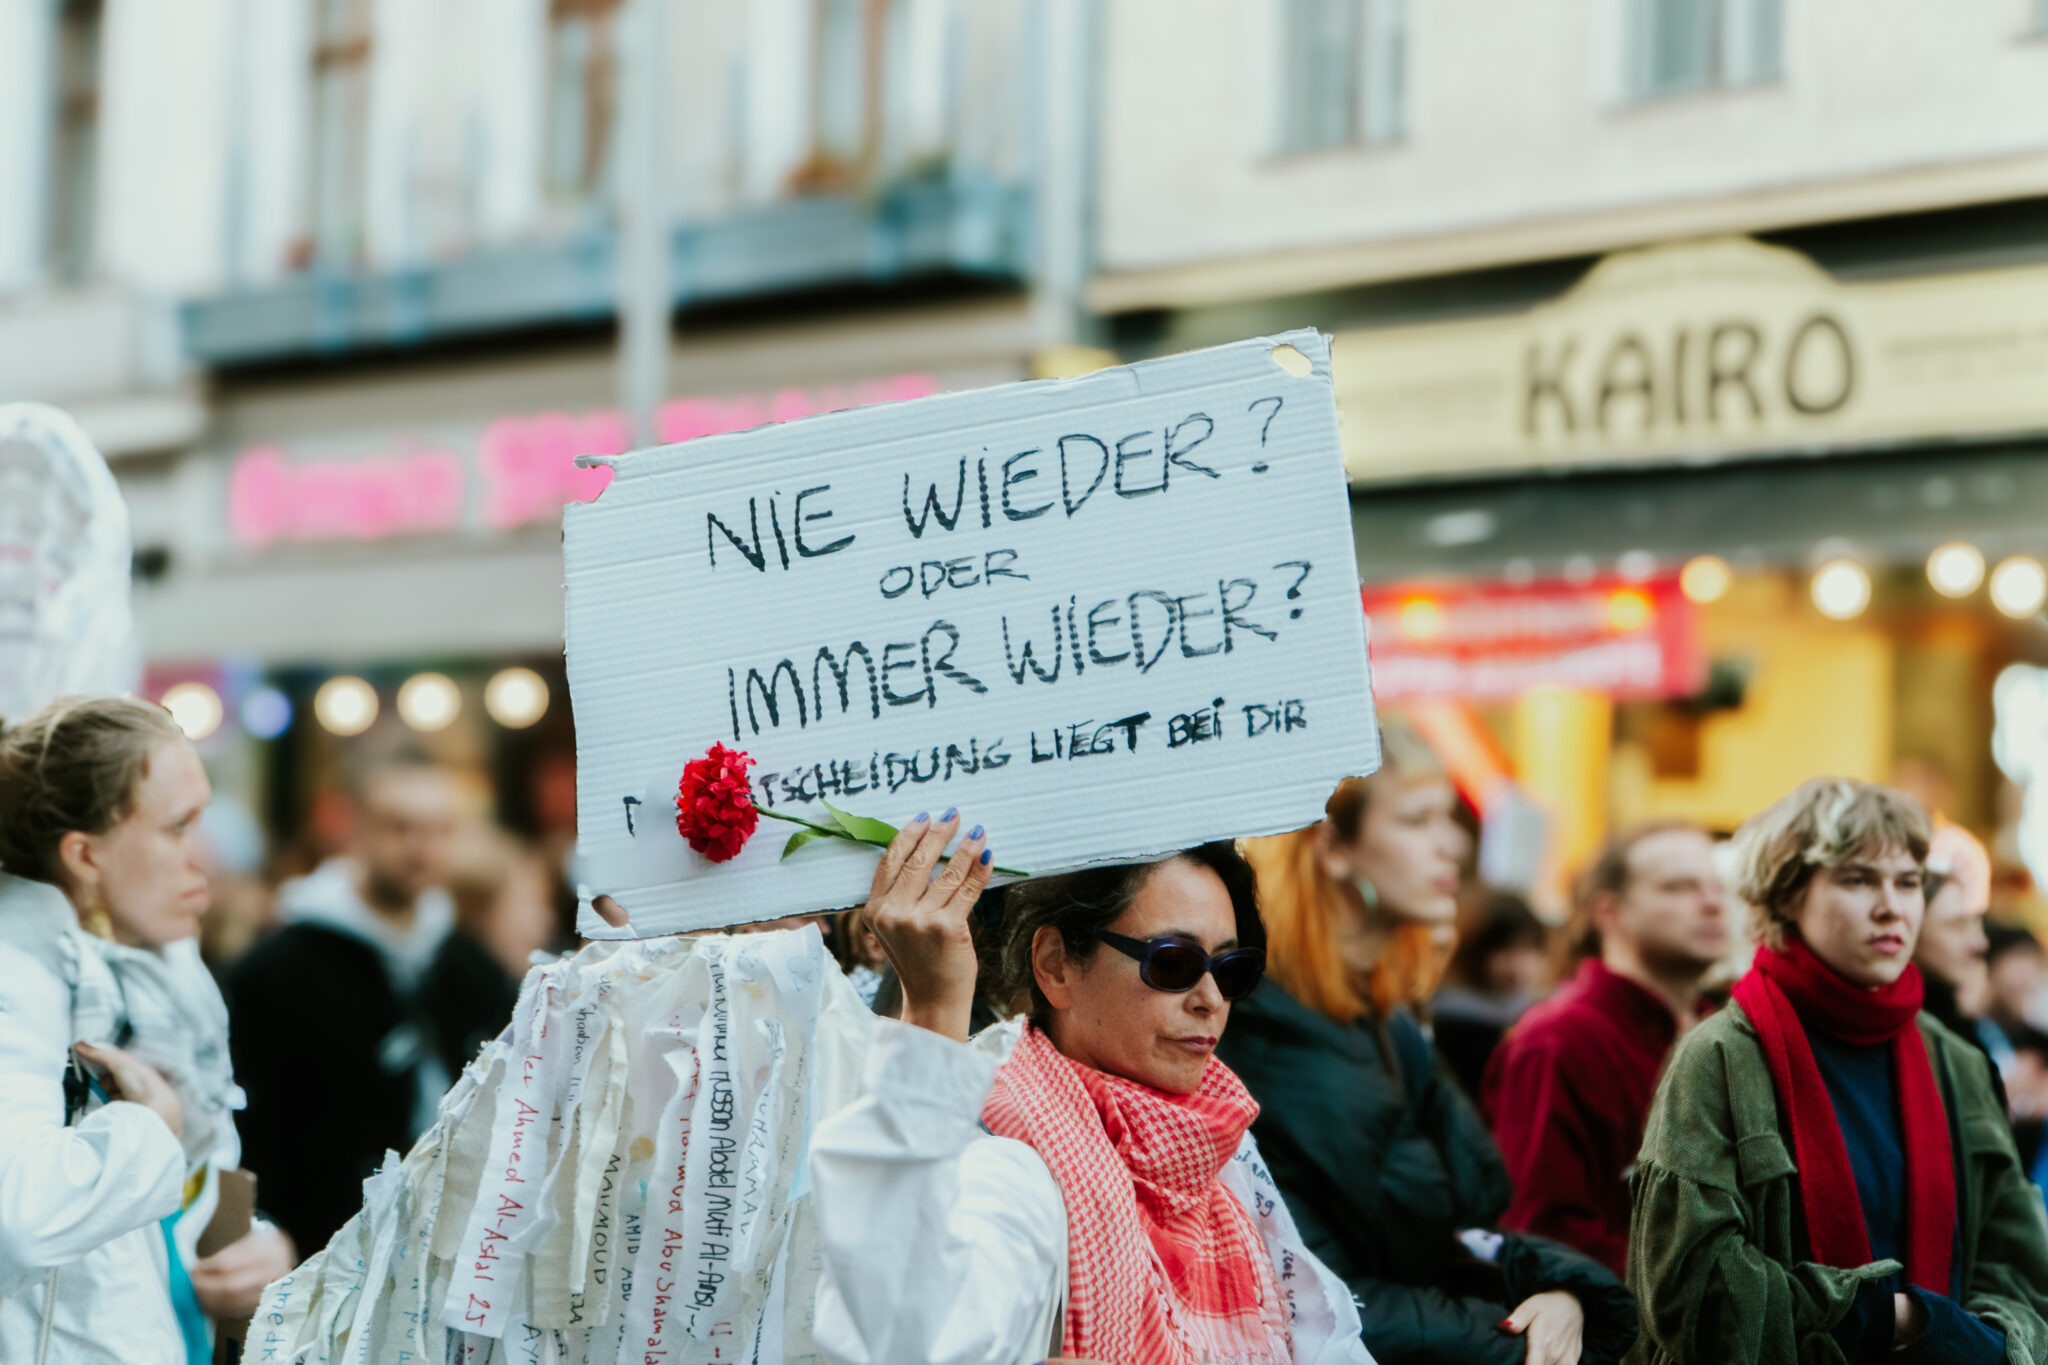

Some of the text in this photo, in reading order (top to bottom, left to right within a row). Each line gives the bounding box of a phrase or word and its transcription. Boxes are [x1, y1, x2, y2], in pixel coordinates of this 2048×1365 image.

[1521, 309, 1859, 438] KAIRO
[707, 484, 856, 572] NIE
[880, 549, 1030, 600] ODER
[727, 620, 988, 742] IMMER
[746, 737, 1012, 808] TSCHEIDUNG
[1031, 711, 1151, 763] LIEGT
[504, 1097, 540, 1183] Ahmed
[660, 1228, 683, 1271] Abu
[465, 1293, 491, 1328] 25
